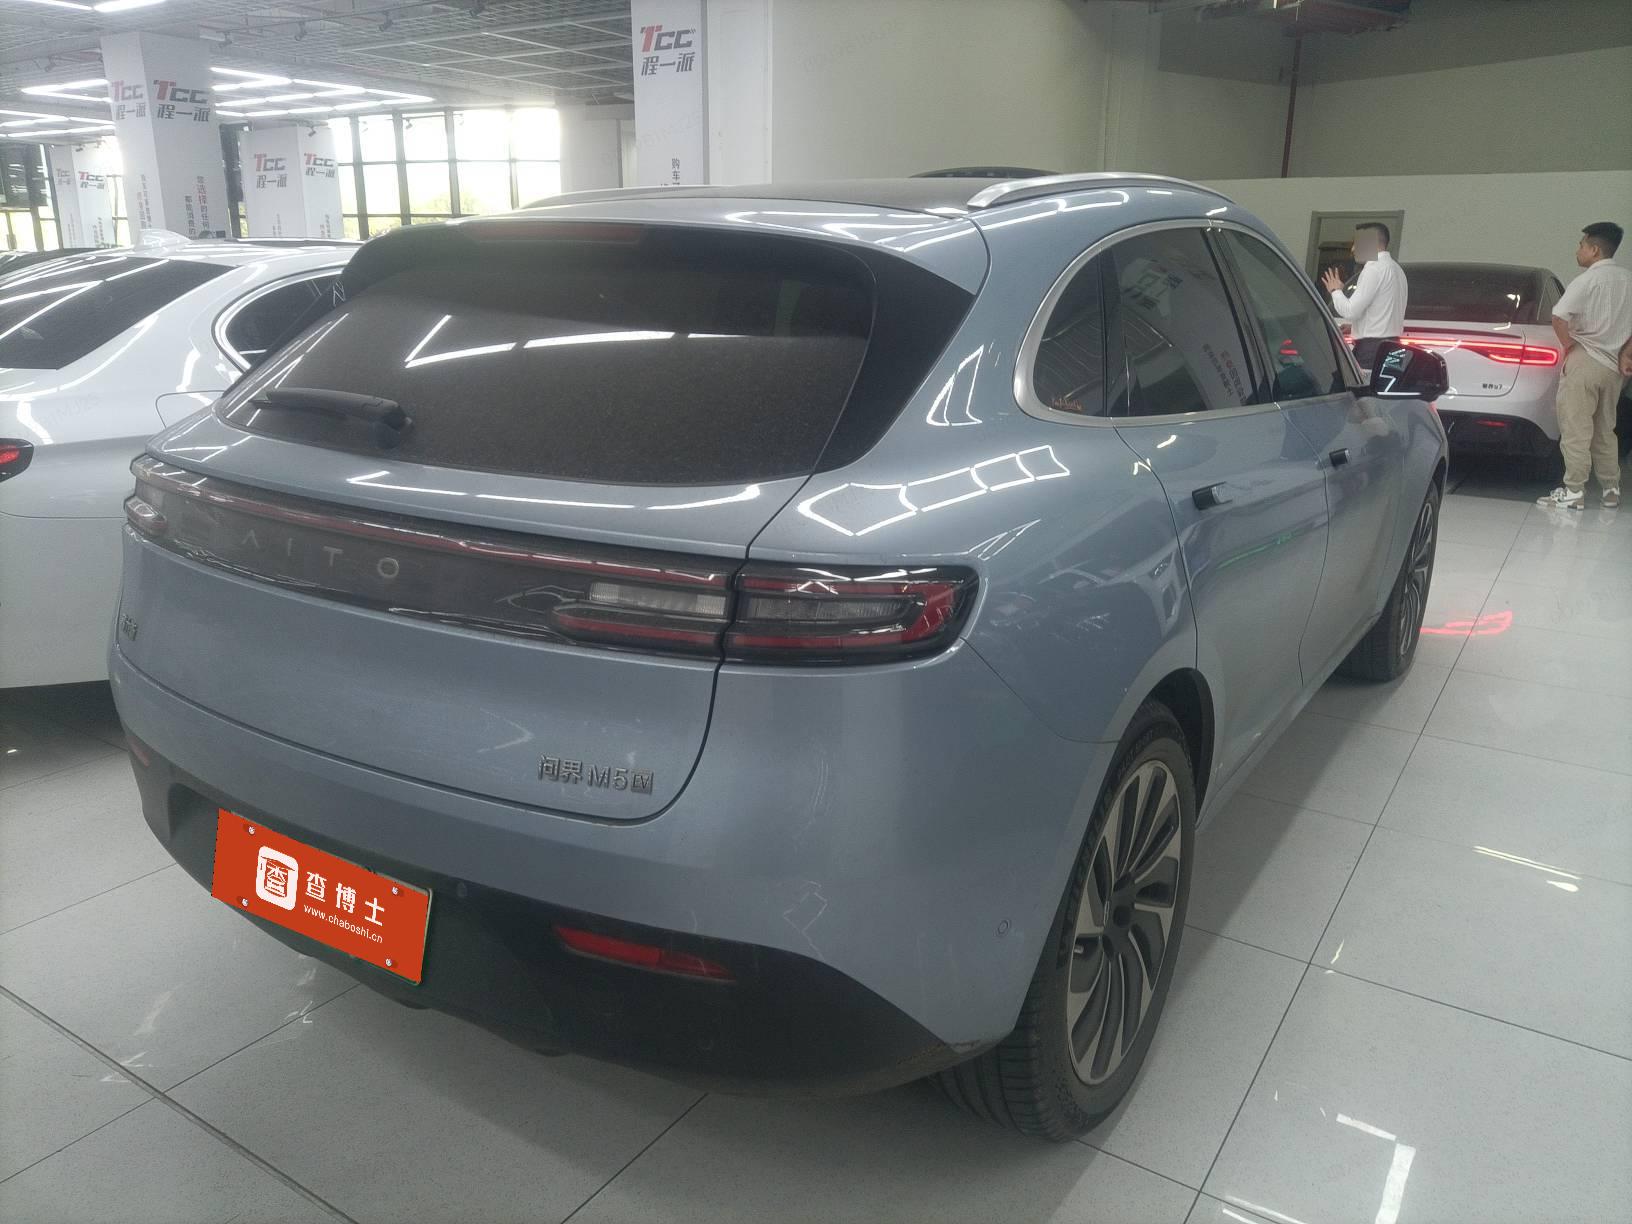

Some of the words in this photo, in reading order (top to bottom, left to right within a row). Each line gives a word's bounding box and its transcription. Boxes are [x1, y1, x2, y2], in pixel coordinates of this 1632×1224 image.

[641, 52, 695, 76] 程一派
[157, 103, 210, 121] 程一派
[671, 158, 681, 186] 购车
[241, 529, 400, 580] AITO
[539, 754, 583, 784] 问界
[587, 763, 628, 791] M5
